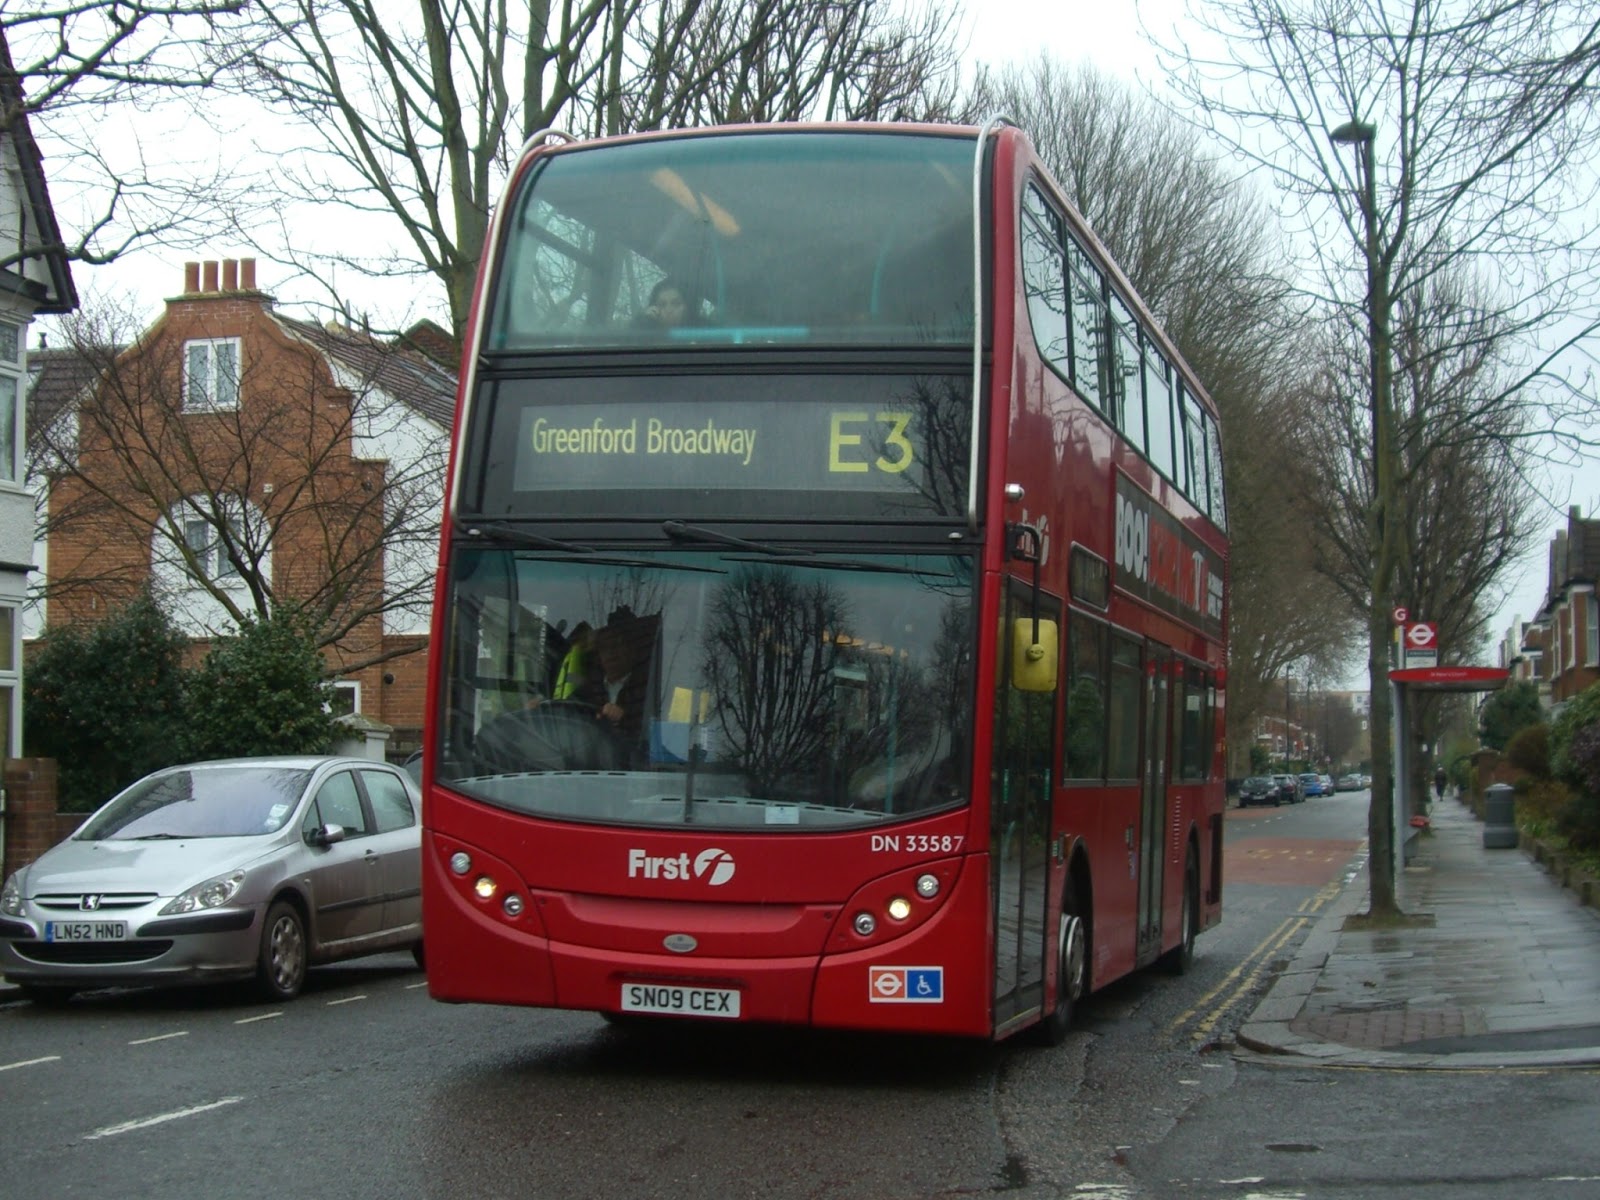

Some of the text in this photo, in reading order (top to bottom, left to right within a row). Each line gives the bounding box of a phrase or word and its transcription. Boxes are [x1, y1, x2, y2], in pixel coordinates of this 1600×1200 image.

[531, 417, 757, 466] Greenford Broadway
[828, 411, 914, 473] E3
[1394, 608, 1407, 622] G
[871, 835, 965, 853] DN 33587
[628, 849, 691, 880] First
[54, 924, 125, 940] LN52 HND
[630, 986, 731, 1013] SN09 CEX
